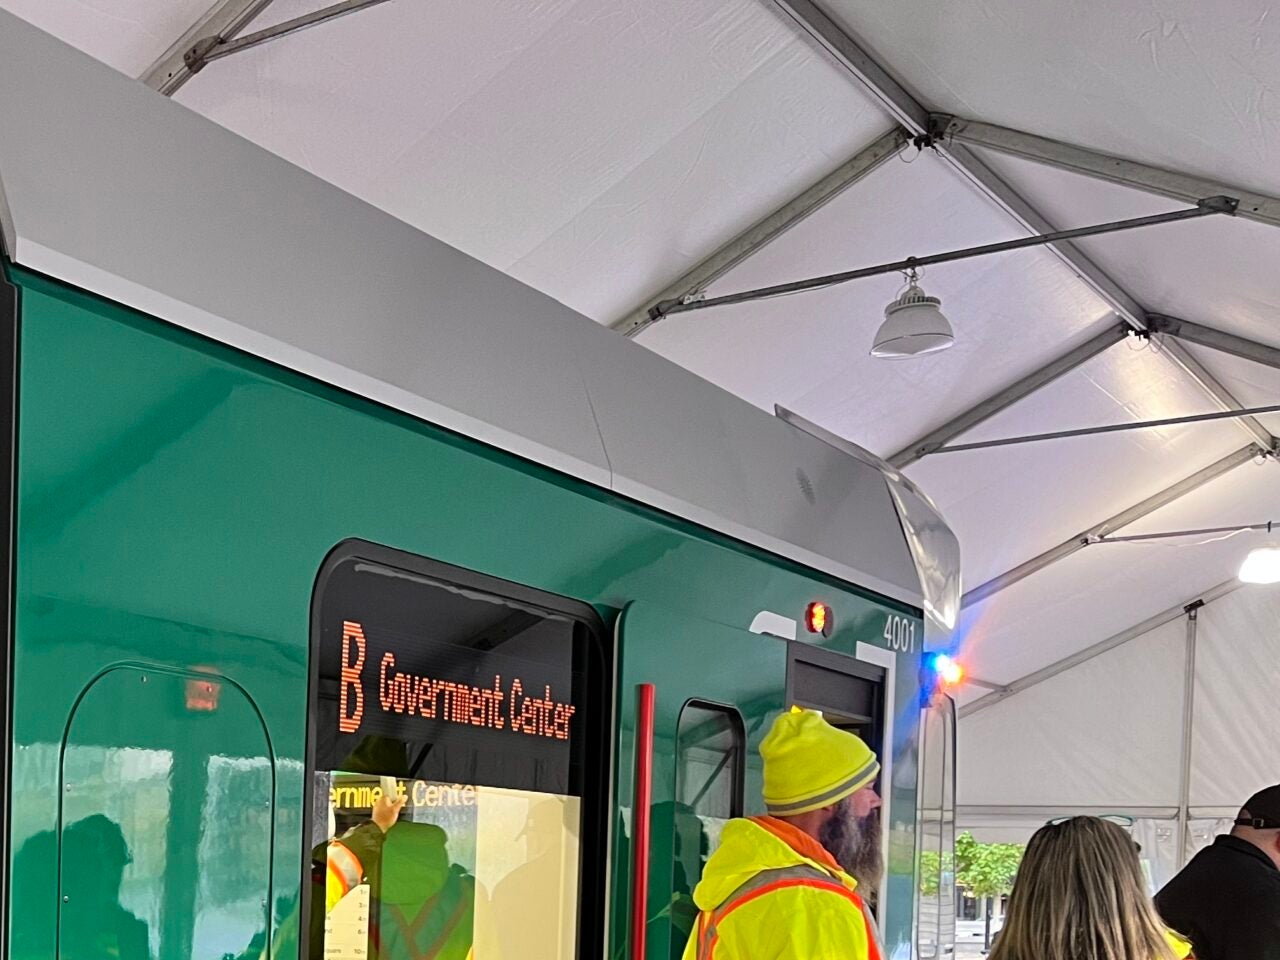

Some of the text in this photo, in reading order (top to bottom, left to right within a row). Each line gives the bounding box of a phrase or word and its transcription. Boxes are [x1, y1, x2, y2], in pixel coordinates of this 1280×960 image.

[883, 615, 915, 653] 4001
[339, 620, 576, 740] B Government Center
[329, 780, 407, 808] ernmet
